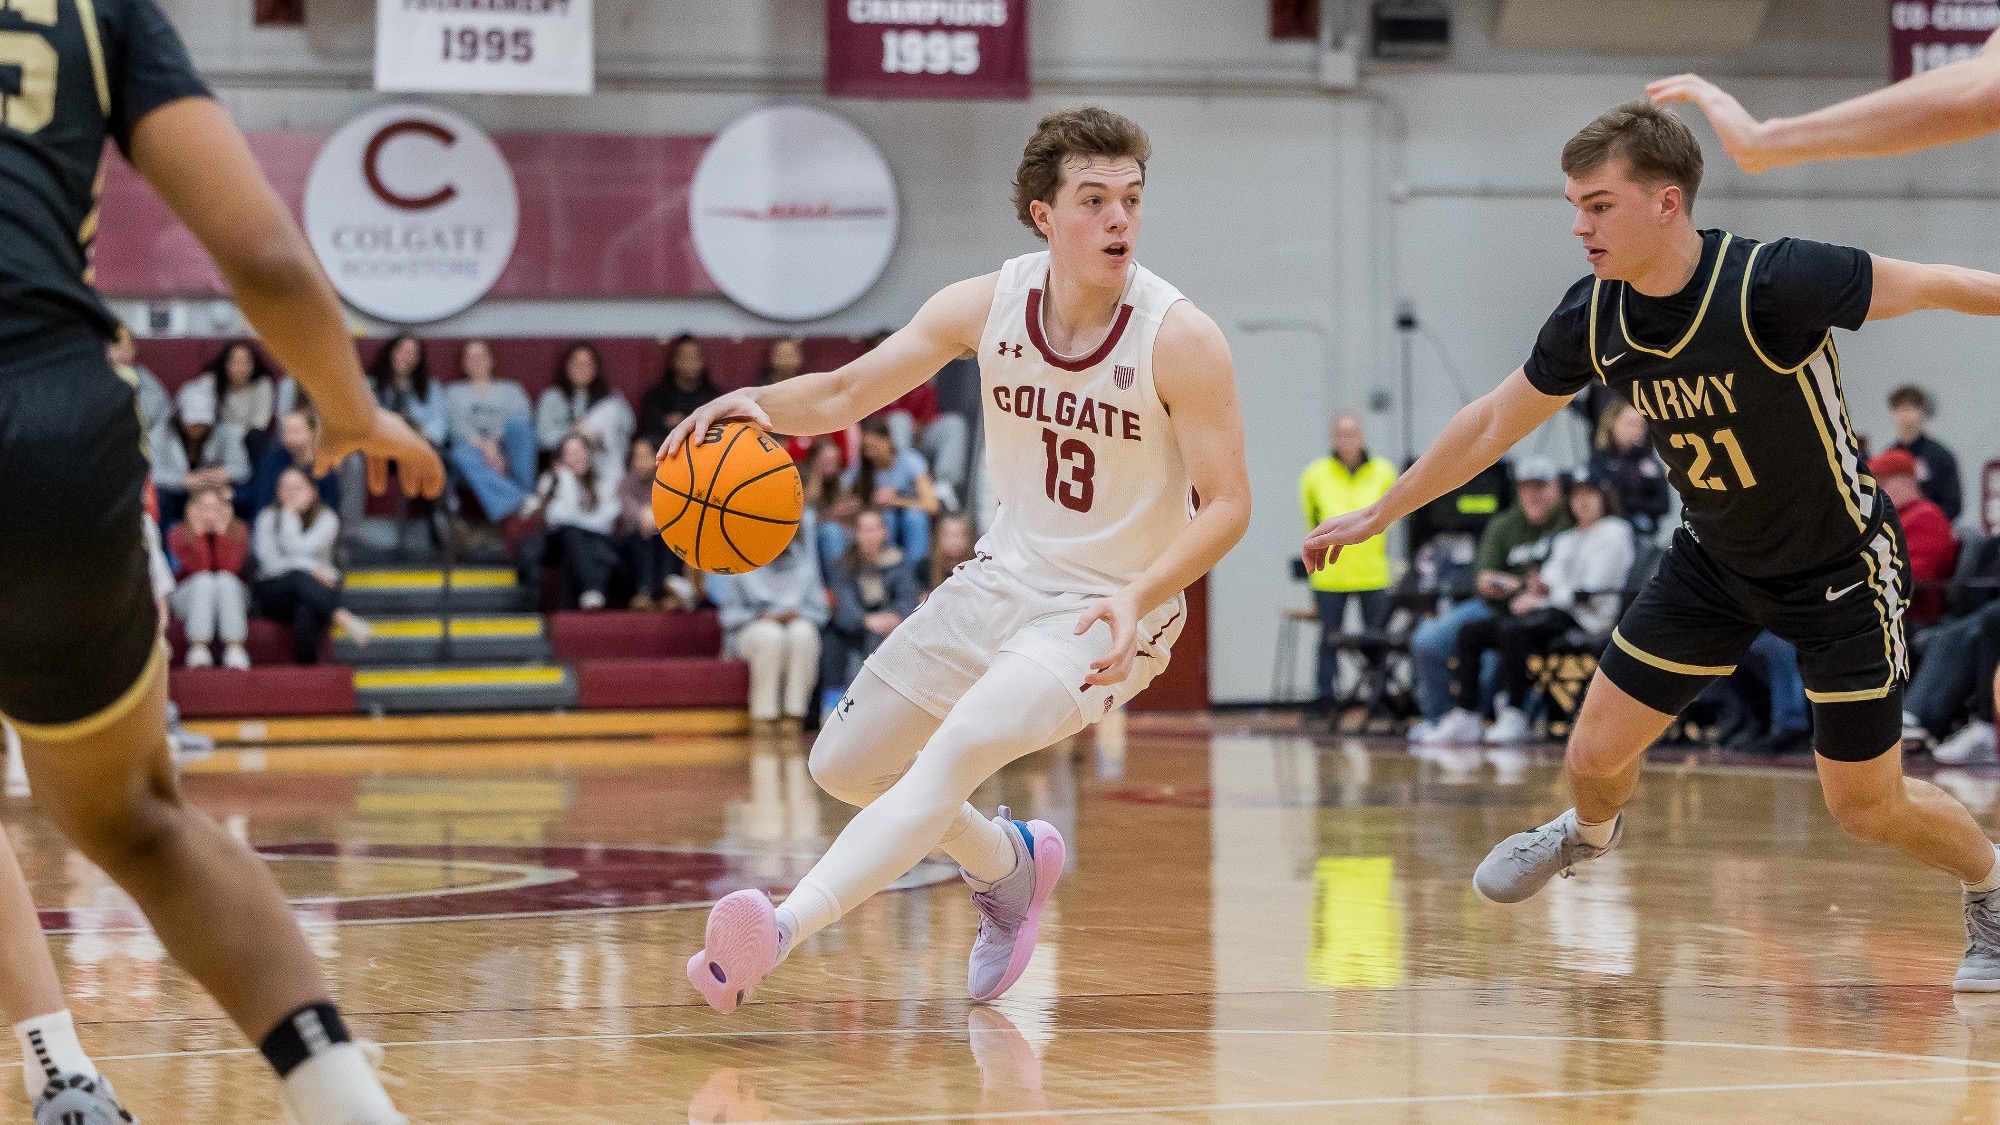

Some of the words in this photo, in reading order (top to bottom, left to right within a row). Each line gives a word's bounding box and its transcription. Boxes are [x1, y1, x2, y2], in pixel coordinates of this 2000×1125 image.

[441, 26, 534, 64] 1995
[881, 29, 980, 75] 1995
[363, 119, 458, 212] C
[330, 226, 490, 252] COLGATE
[993, 385, 1142, 442] COLGATE
[1632, 372, 1738, 420] ARMY
[1041, 426, 1096, 513] 13
[1669, 428, 1758, 491] 21
